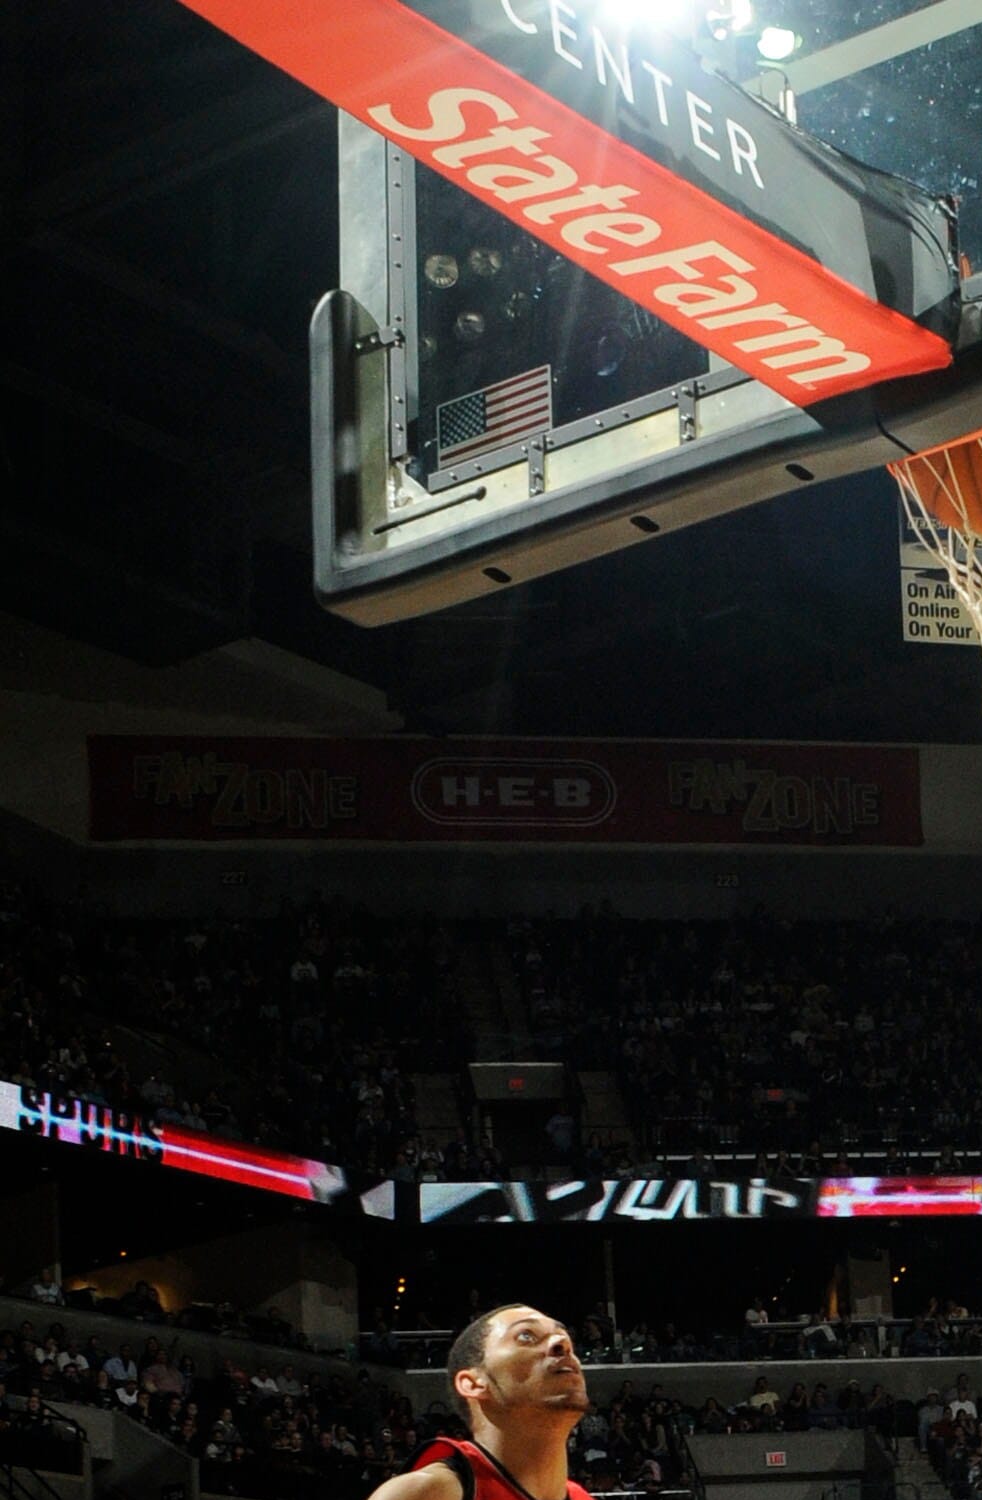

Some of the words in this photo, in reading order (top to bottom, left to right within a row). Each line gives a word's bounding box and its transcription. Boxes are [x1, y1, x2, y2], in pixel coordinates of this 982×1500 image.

[907, 582, 929, 598] On
[908, 602, 960, 619] Online
[909, 621, 931, 637] On
[936, 622, 973, 638] Your
